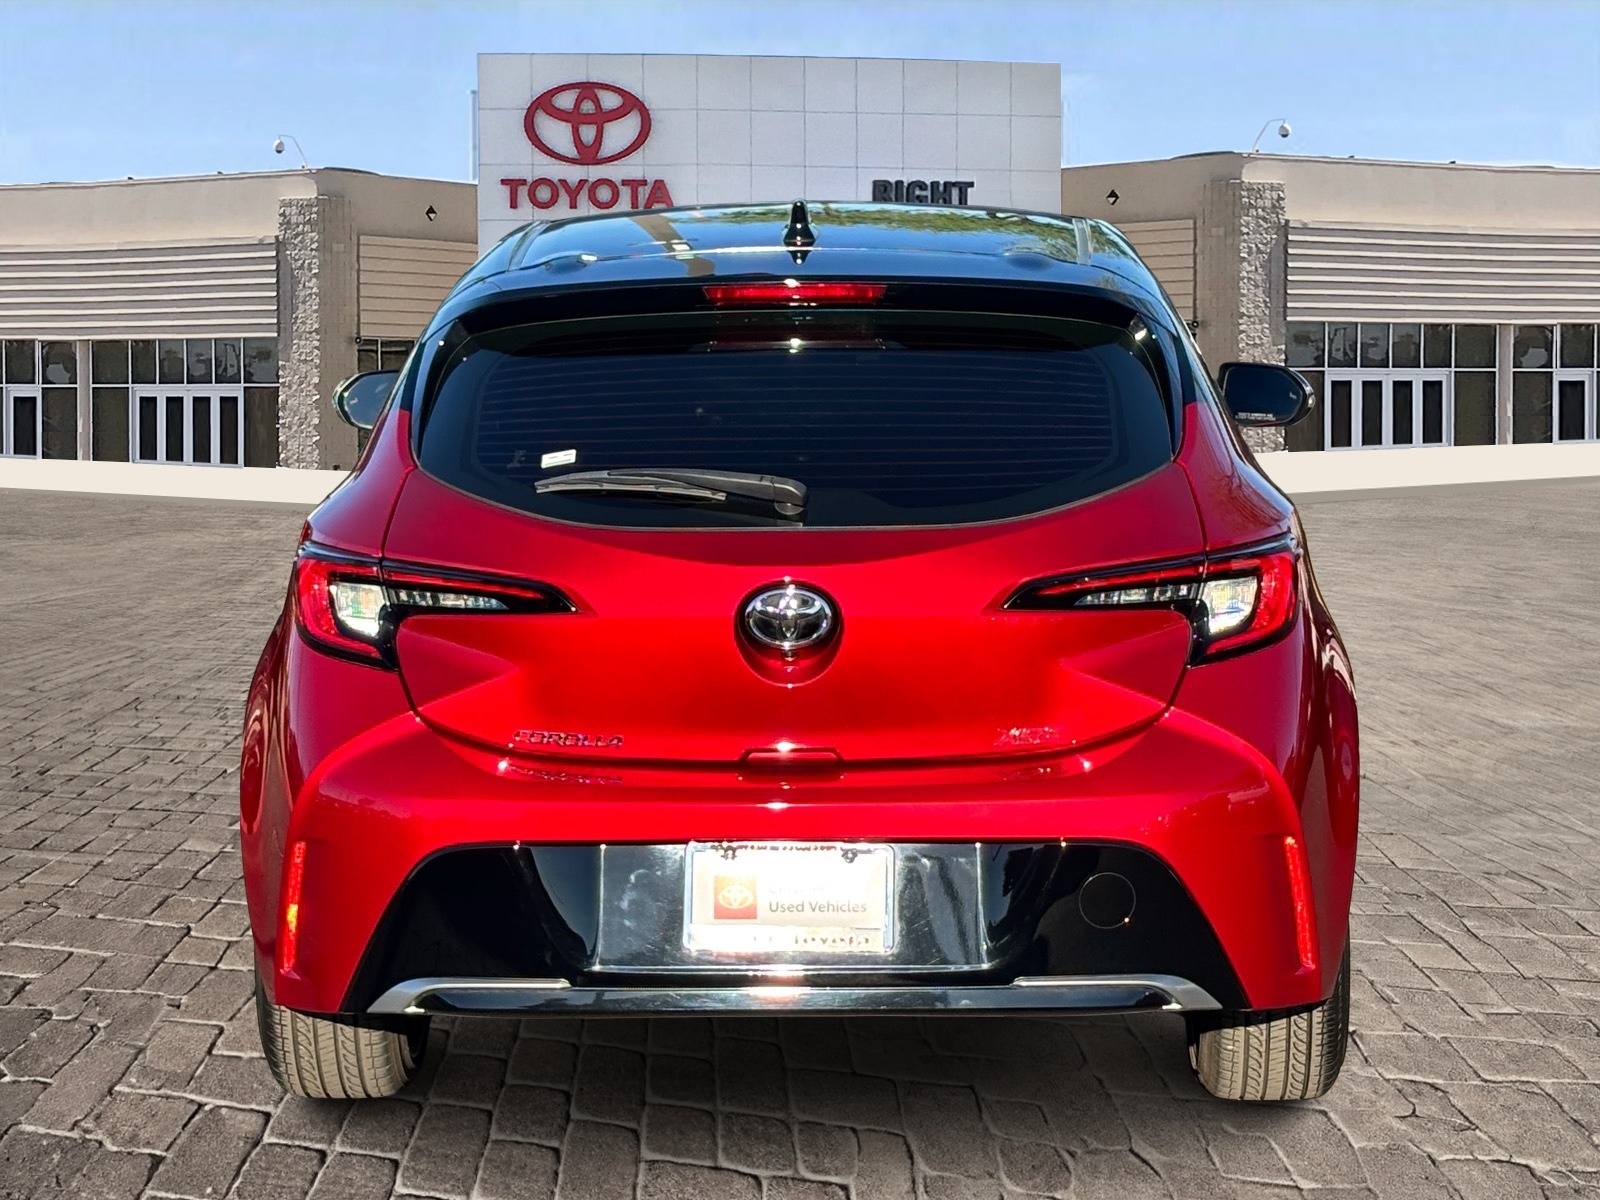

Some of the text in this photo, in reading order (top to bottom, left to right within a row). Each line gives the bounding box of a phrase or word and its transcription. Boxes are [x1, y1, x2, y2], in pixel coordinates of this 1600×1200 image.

[500, 177, 674, 209] TOYOTA
[872, 179, 975, 206] RIGHT
[769, 900, 867, 913] Used Vehicles
